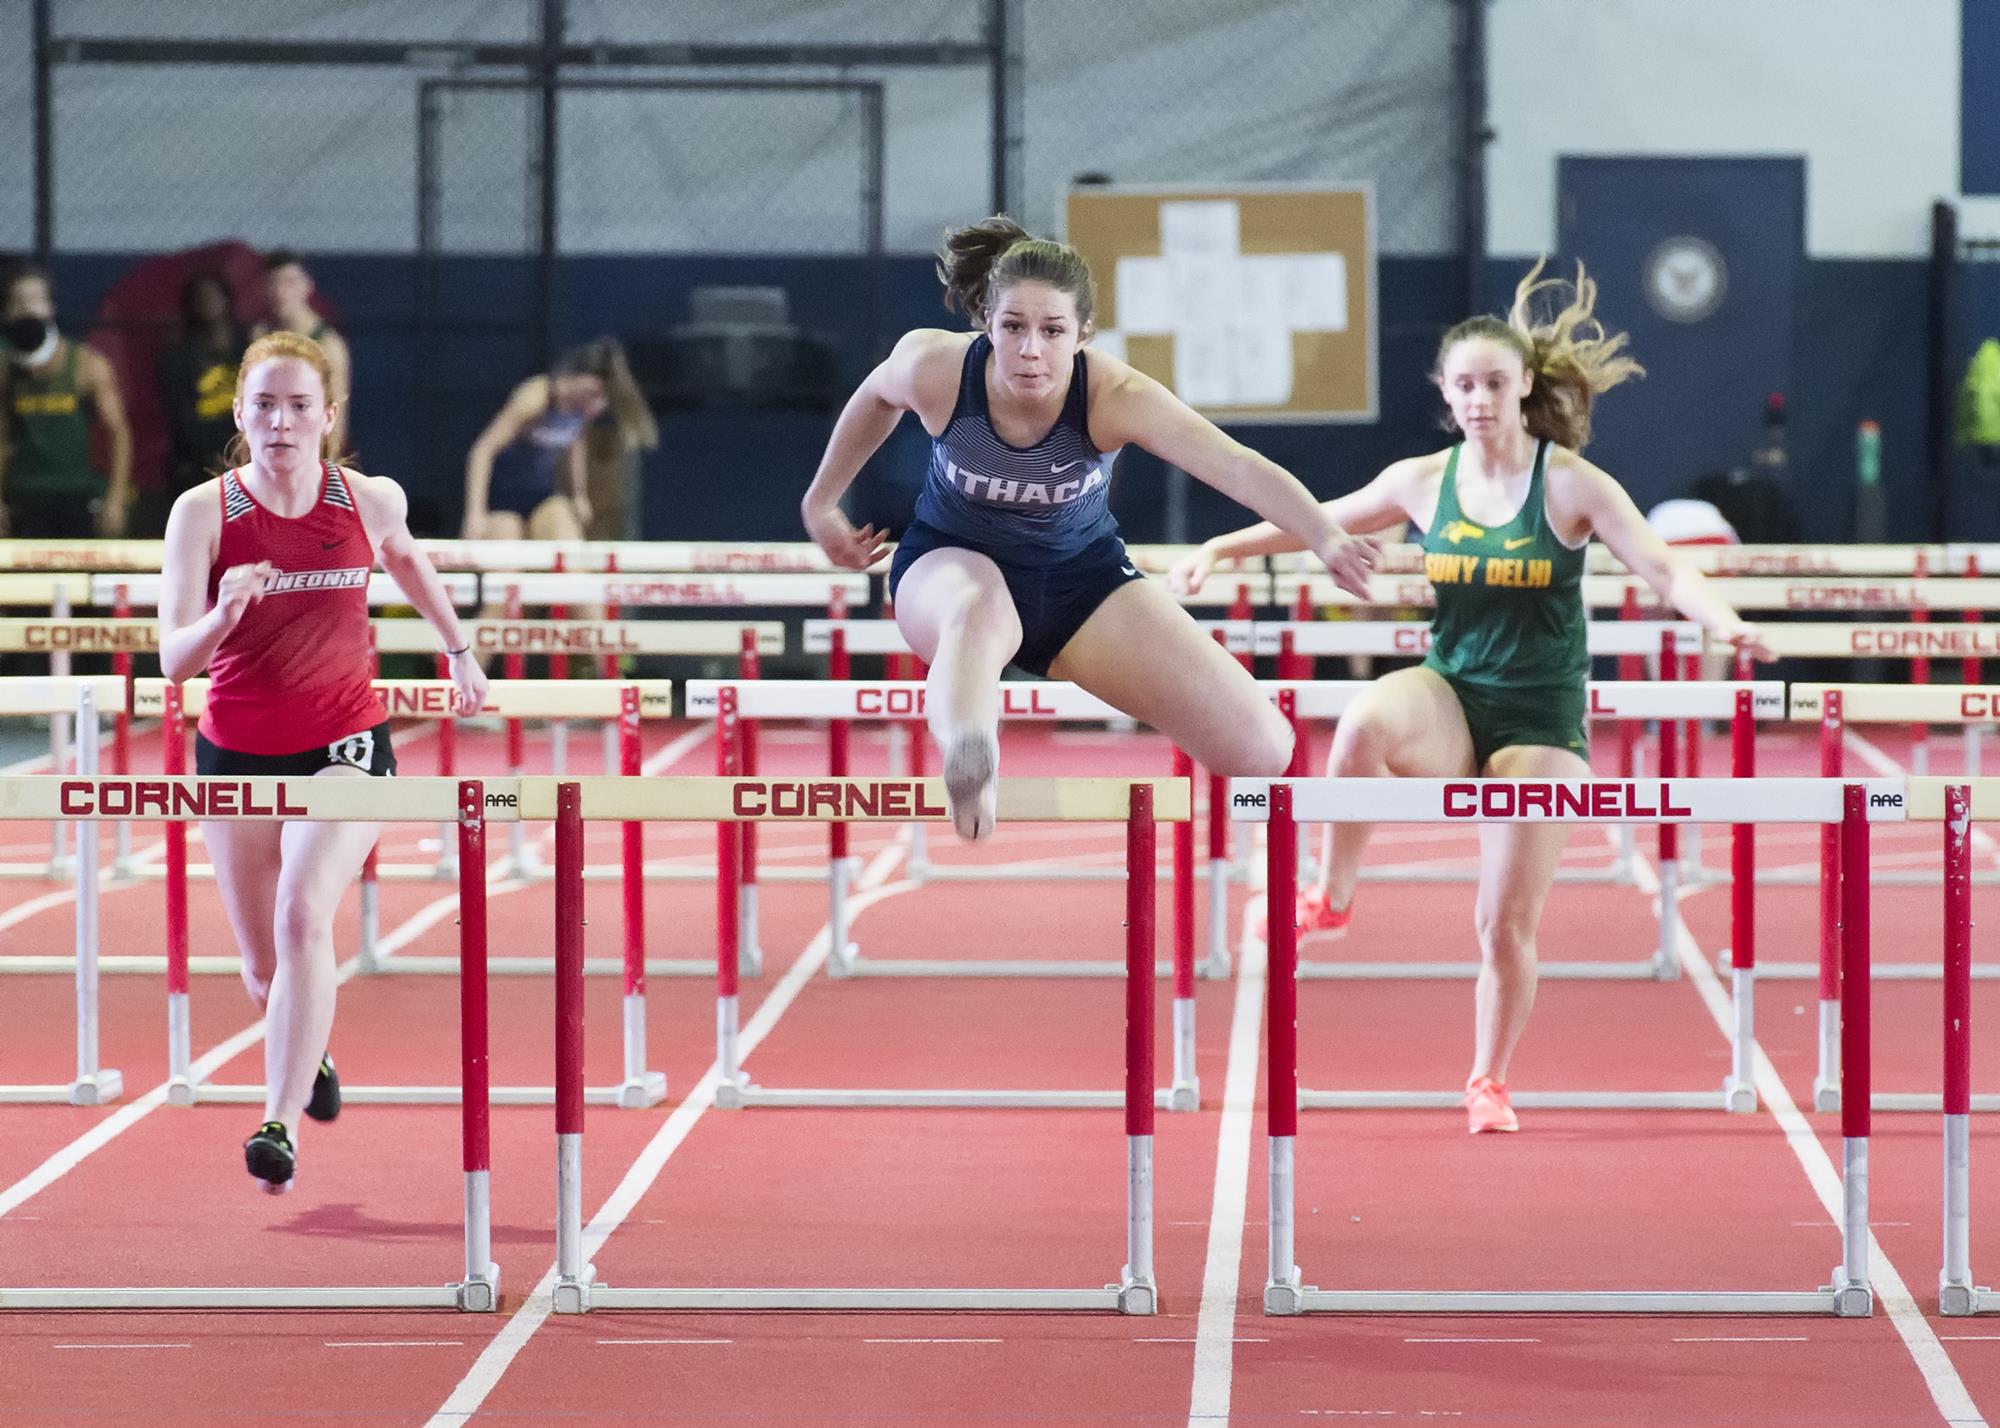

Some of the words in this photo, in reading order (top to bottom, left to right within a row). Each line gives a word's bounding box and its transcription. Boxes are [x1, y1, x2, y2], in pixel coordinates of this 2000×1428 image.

[946, 460, 1101, 504] ITHACA
[1484, 557, 1552, 588] DELHI
[25, 626, 159, 646] CORNEL
[477, 626, 639, 647] CORNELL
[1852, 630, 2000, 651] CORNEL
[856, 689, 1055, 714] COLL
[61, 781, 308, 816] CORNELL
[733, 782, 946, 817] CORNEL
[1443, 783, 1692, 817] CORNELL
